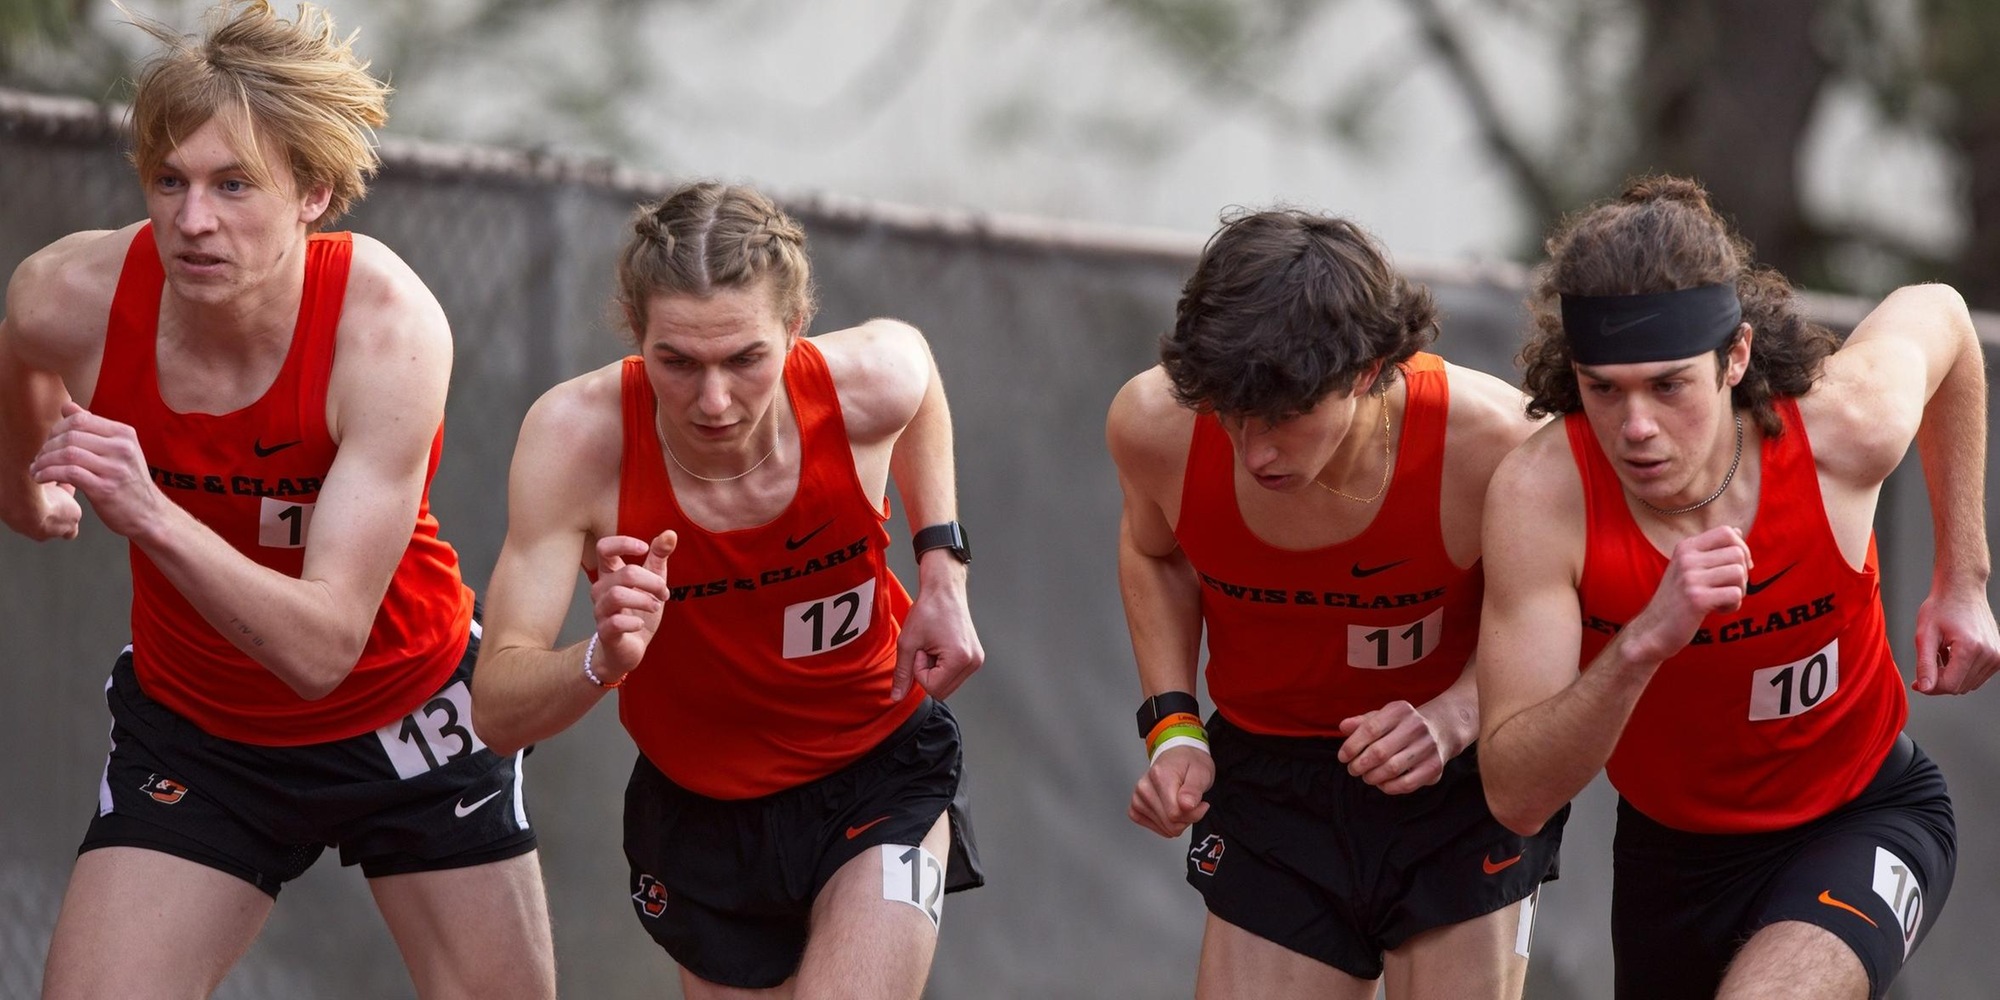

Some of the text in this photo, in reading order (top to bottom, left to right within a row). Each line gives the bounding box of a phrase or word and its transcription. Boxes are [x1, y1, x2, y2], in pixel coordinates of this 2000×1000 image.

[203, 475, 227, 495] &
[231, 475, 322, 497] CLAR
[278, 505, 303, 546] 1
[669, 536, 869, 602] WIS & CLARK
[1199, 572, 1447, 609] EWIS & CLARK
[800, 591, 860, 652] 12
[1364, 621, 1424, 667] 11
[1719, 593, 1836, 643] CLARK
[1769, 653, 1828, 716] 10
[399, 697, 473, 769] 13
[899, 847, 941, 926] 12
[1891, 864, 1921, 942] 10
